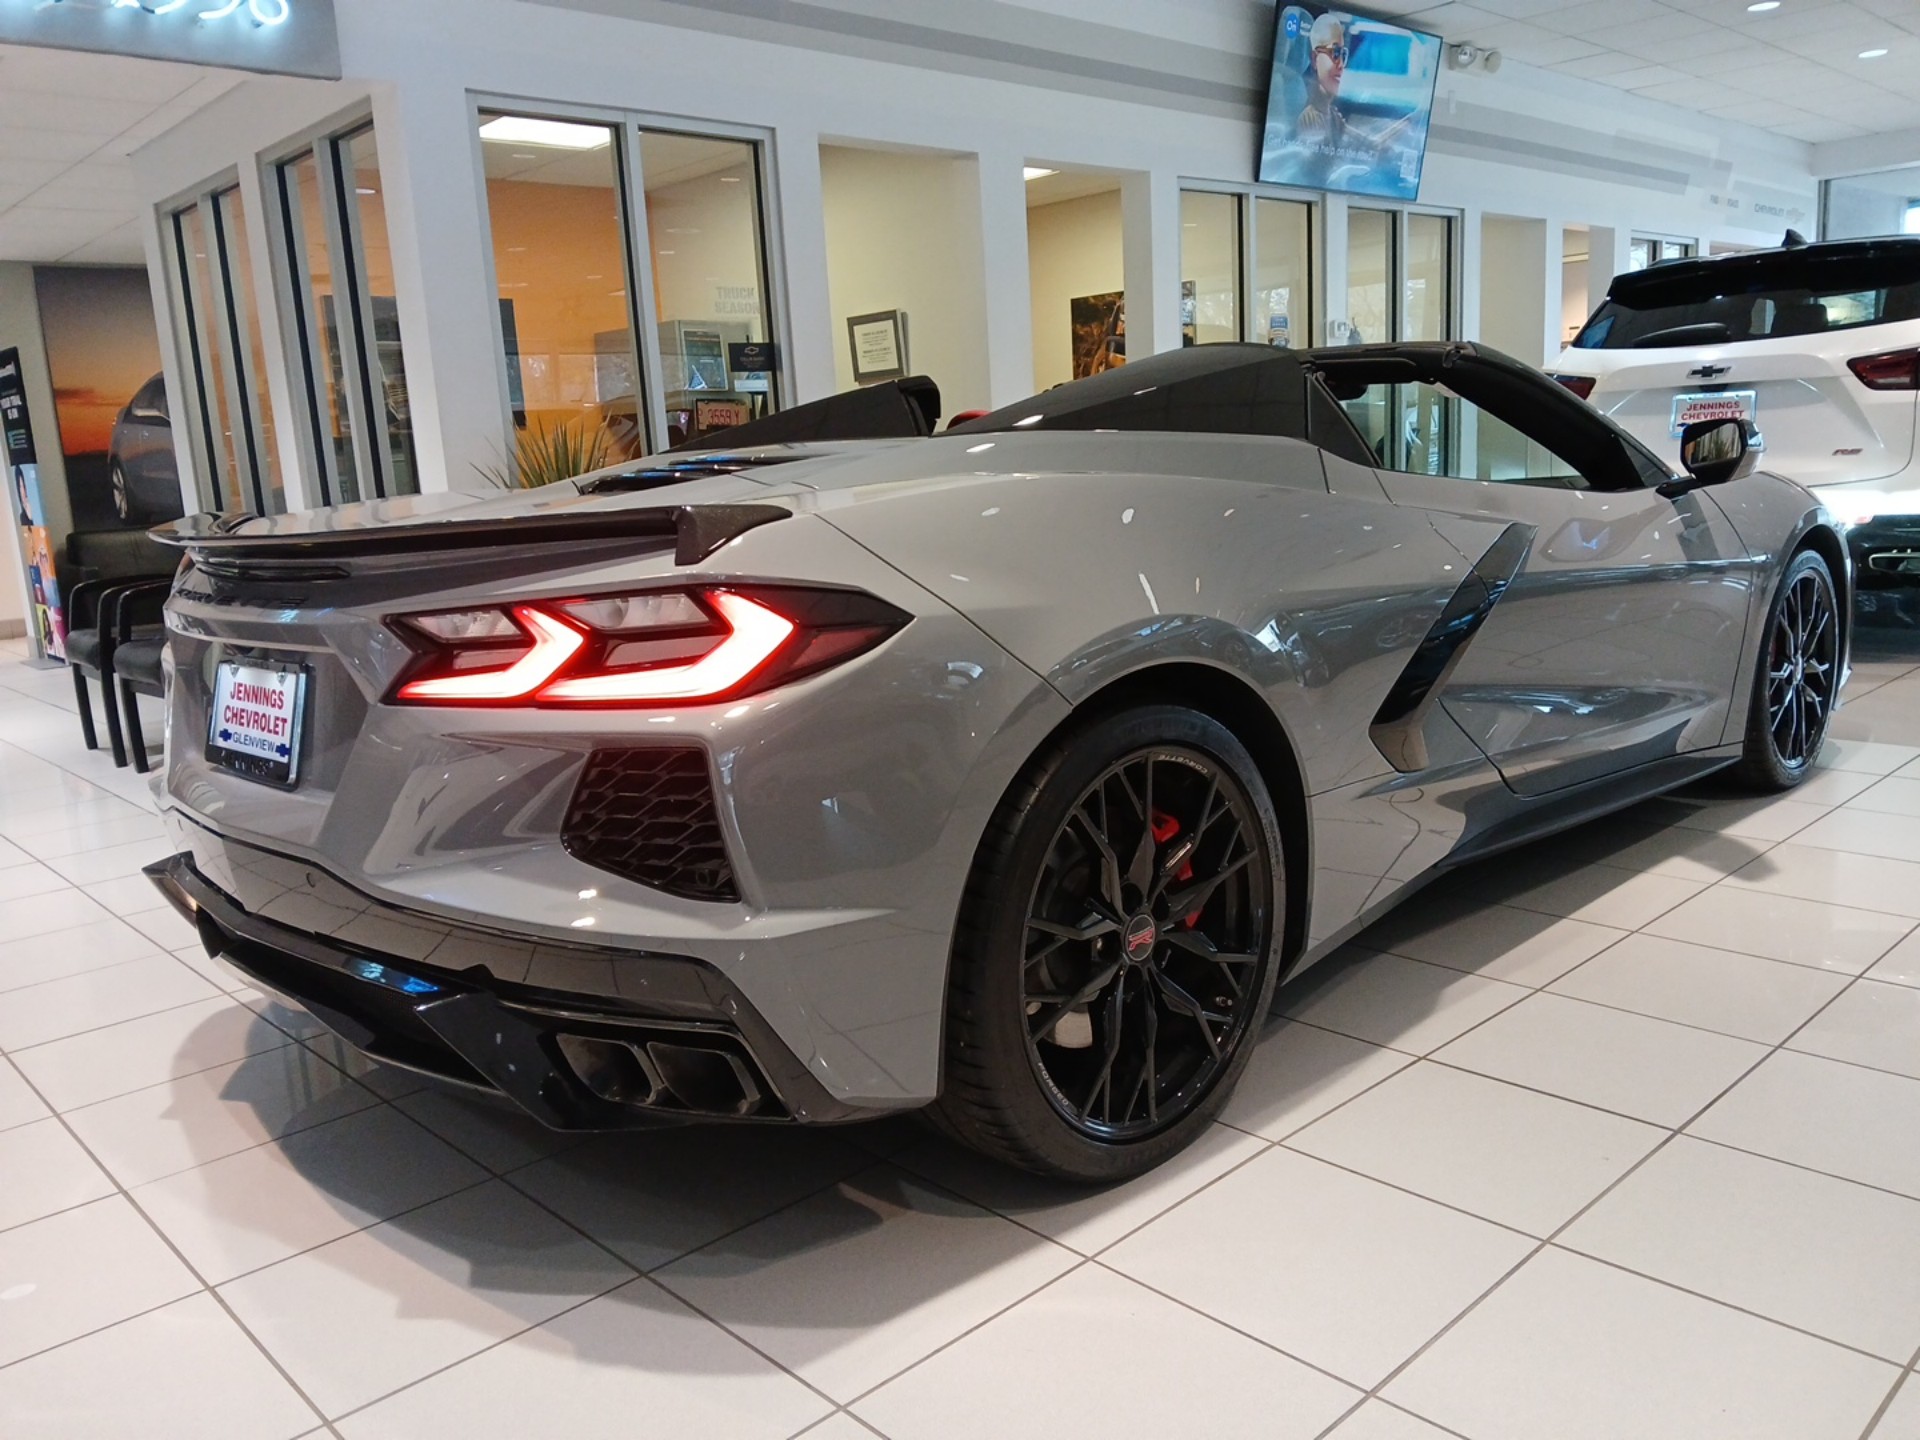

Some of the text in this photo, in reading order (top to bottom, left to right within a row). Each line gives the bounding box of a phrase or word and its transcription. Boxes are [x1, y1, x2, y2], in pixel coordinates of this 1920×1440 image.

[1321, 144, 1335, 156] help
[1686, 401, 1740, 411] JENNINGS
[1681, 410, 1744, 421] CHEVROLET
[230, 681, 285, 711] JENNINGS
[223, 705, 288, 737] CHEVROLET
[232, 731, 277, 752] GLENVIEW
